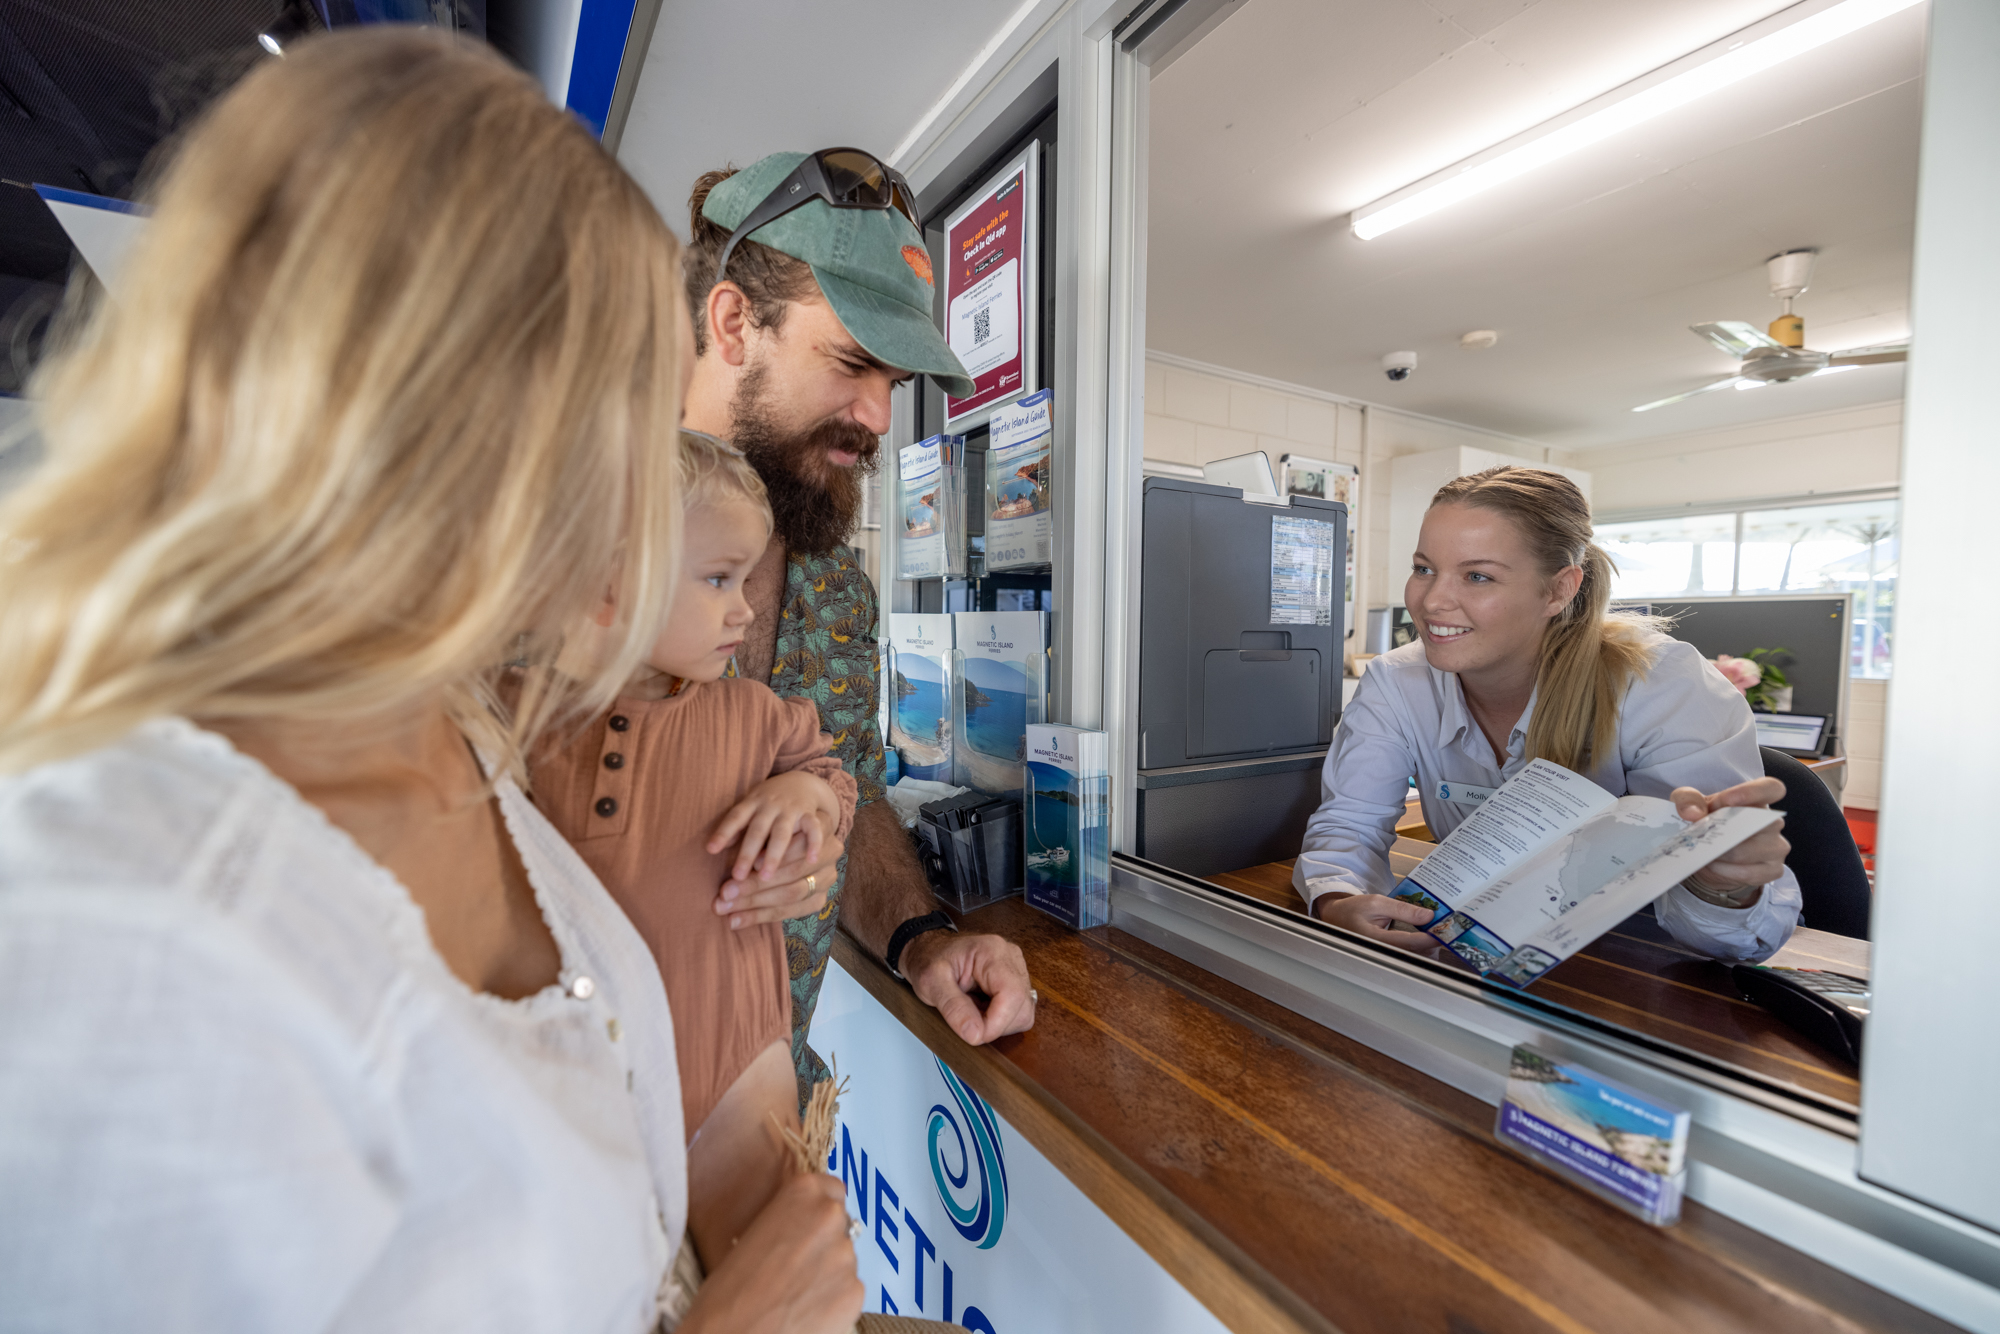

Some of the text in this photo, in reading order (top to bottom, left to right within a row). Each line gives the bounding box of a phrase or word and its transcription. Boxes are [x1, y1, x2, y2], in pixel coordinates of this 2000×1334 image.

[963, 210, 1008, 250] Stay safe with the
[964, 225, 1006, 261] Check In Qld app
[962, 289, 1002, 321] Magnetic Island Ferries
[1012, 413, 1029, 429] Island
[1031, 407, 1046, 424] Guide
[915, 452, 927, 464] Island
[929, 448, 939, 461] Guide
[1309, 660, 1314, 673] 1
[1034, 749, 1073, 762] MAGNETIC ISLAND
[1556, 773, 1570, 781] VISIT
[1466, 791, 1489, 800] Molly
[1521, 815, 1538, 826] FLORENCE
[1520, 1110, 1569, 1147] MAGNETIC
[1571, 1140, 1610, 1168] ISLAND
